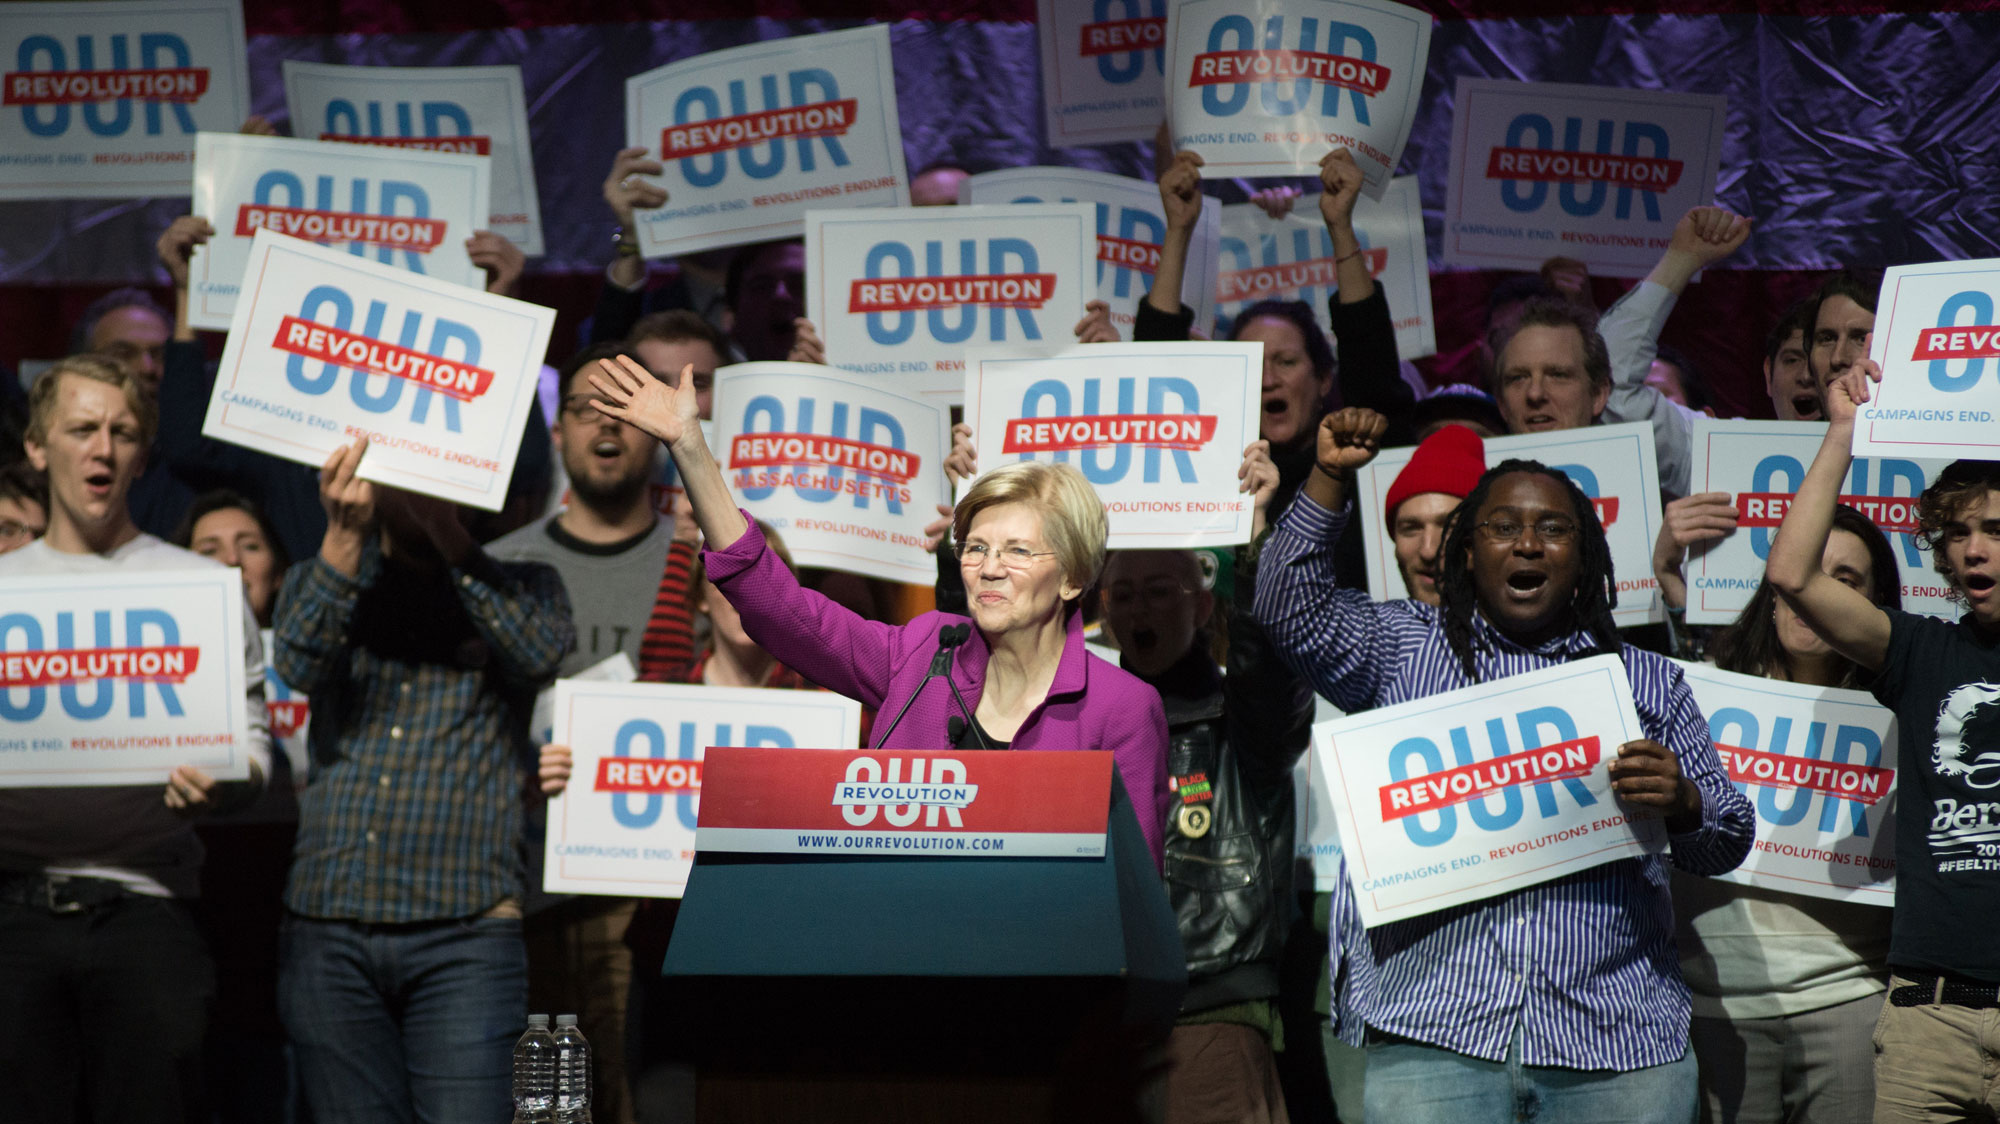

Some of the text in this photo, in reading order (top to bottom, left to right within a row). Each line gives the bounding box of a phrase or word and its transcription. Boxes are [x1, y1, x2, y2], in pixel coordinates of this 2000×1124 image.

[14, 73, 198, 98] REVOLUTION
[17, 31, 198, 139] OUR
[1200, 14, 1378, 127] OUR
[1200, 55, 1378, 88] REVOLUTION
[670, 104, 846, 151] REVOLUTION
[674, 67, 851, 188] OUR
[1229, 132, 1260, 144] END.
[1357, 141, 1393, 169] ENDURE.
[1500, 112, 1671, 223] OUR
[1500, 153, 1670, 183] REVOLUTION
[752, 184, 842, 207] REVOLUTIONS
[845, 175, 902, 194] ENDURE.
[248, 209, 434, 244] REVOLUTION
[1561, 230, 1645, 249] REVOLUTIONS
[860, 279, 1043, 304] REVOLUTION
[865, 237, 1043, 346] OUR
[285, 284, 482, 434] OUR
[287, 323, 479, 393] REVOLUTION
[900, 361, 931, 372] END.
[220, 389, 503, 473] CAMPAIGNS END. REVOLUTIONS ENDURE.
[1016, 420, 1201, 444] REVOLUTION
[1019, 377, 1201, 485] OUR
[1864, 408, 1995, 423] CAMPAIGNS END.
[737, 438, 909, 475] REVOLUTION
[741, 394, 906, 516] OUR
[733, 472, 912, 504] MASSACHUSETTS
[1186, 501, 1247, 513] ENDURE.
[795, 517, 888, 542] REVOLUTIONS
[0, 651, 185, 680] EVOLUTION
[0, 608, 186, 724] OUR
[71, 735, 173, 751] REVOLUTIONS
[176, 733, 237, 747] ENDURE.
[1388, 705, 1599, 848] OUR
[1389, 744, 1588, 811] REVOLUTION
[1706, 706, 1883, 839] OUR
[841, 756, 968, 828] OUR
[842, 787, 967, 801] REVOLUTION
[554, 843, 639, 859] CAMPAIGNS
[797, 834, 1005, 851] WWW.OURREVOLUTION.COM
[1361, 861, 1448, 893] CAMPAIGNS
[1451, 853, 1486, 872] END.
[1488, 823, 1589, 861] REVOLUTIONS
[1754, 839, 1852, 865] REVOLUTIONS
